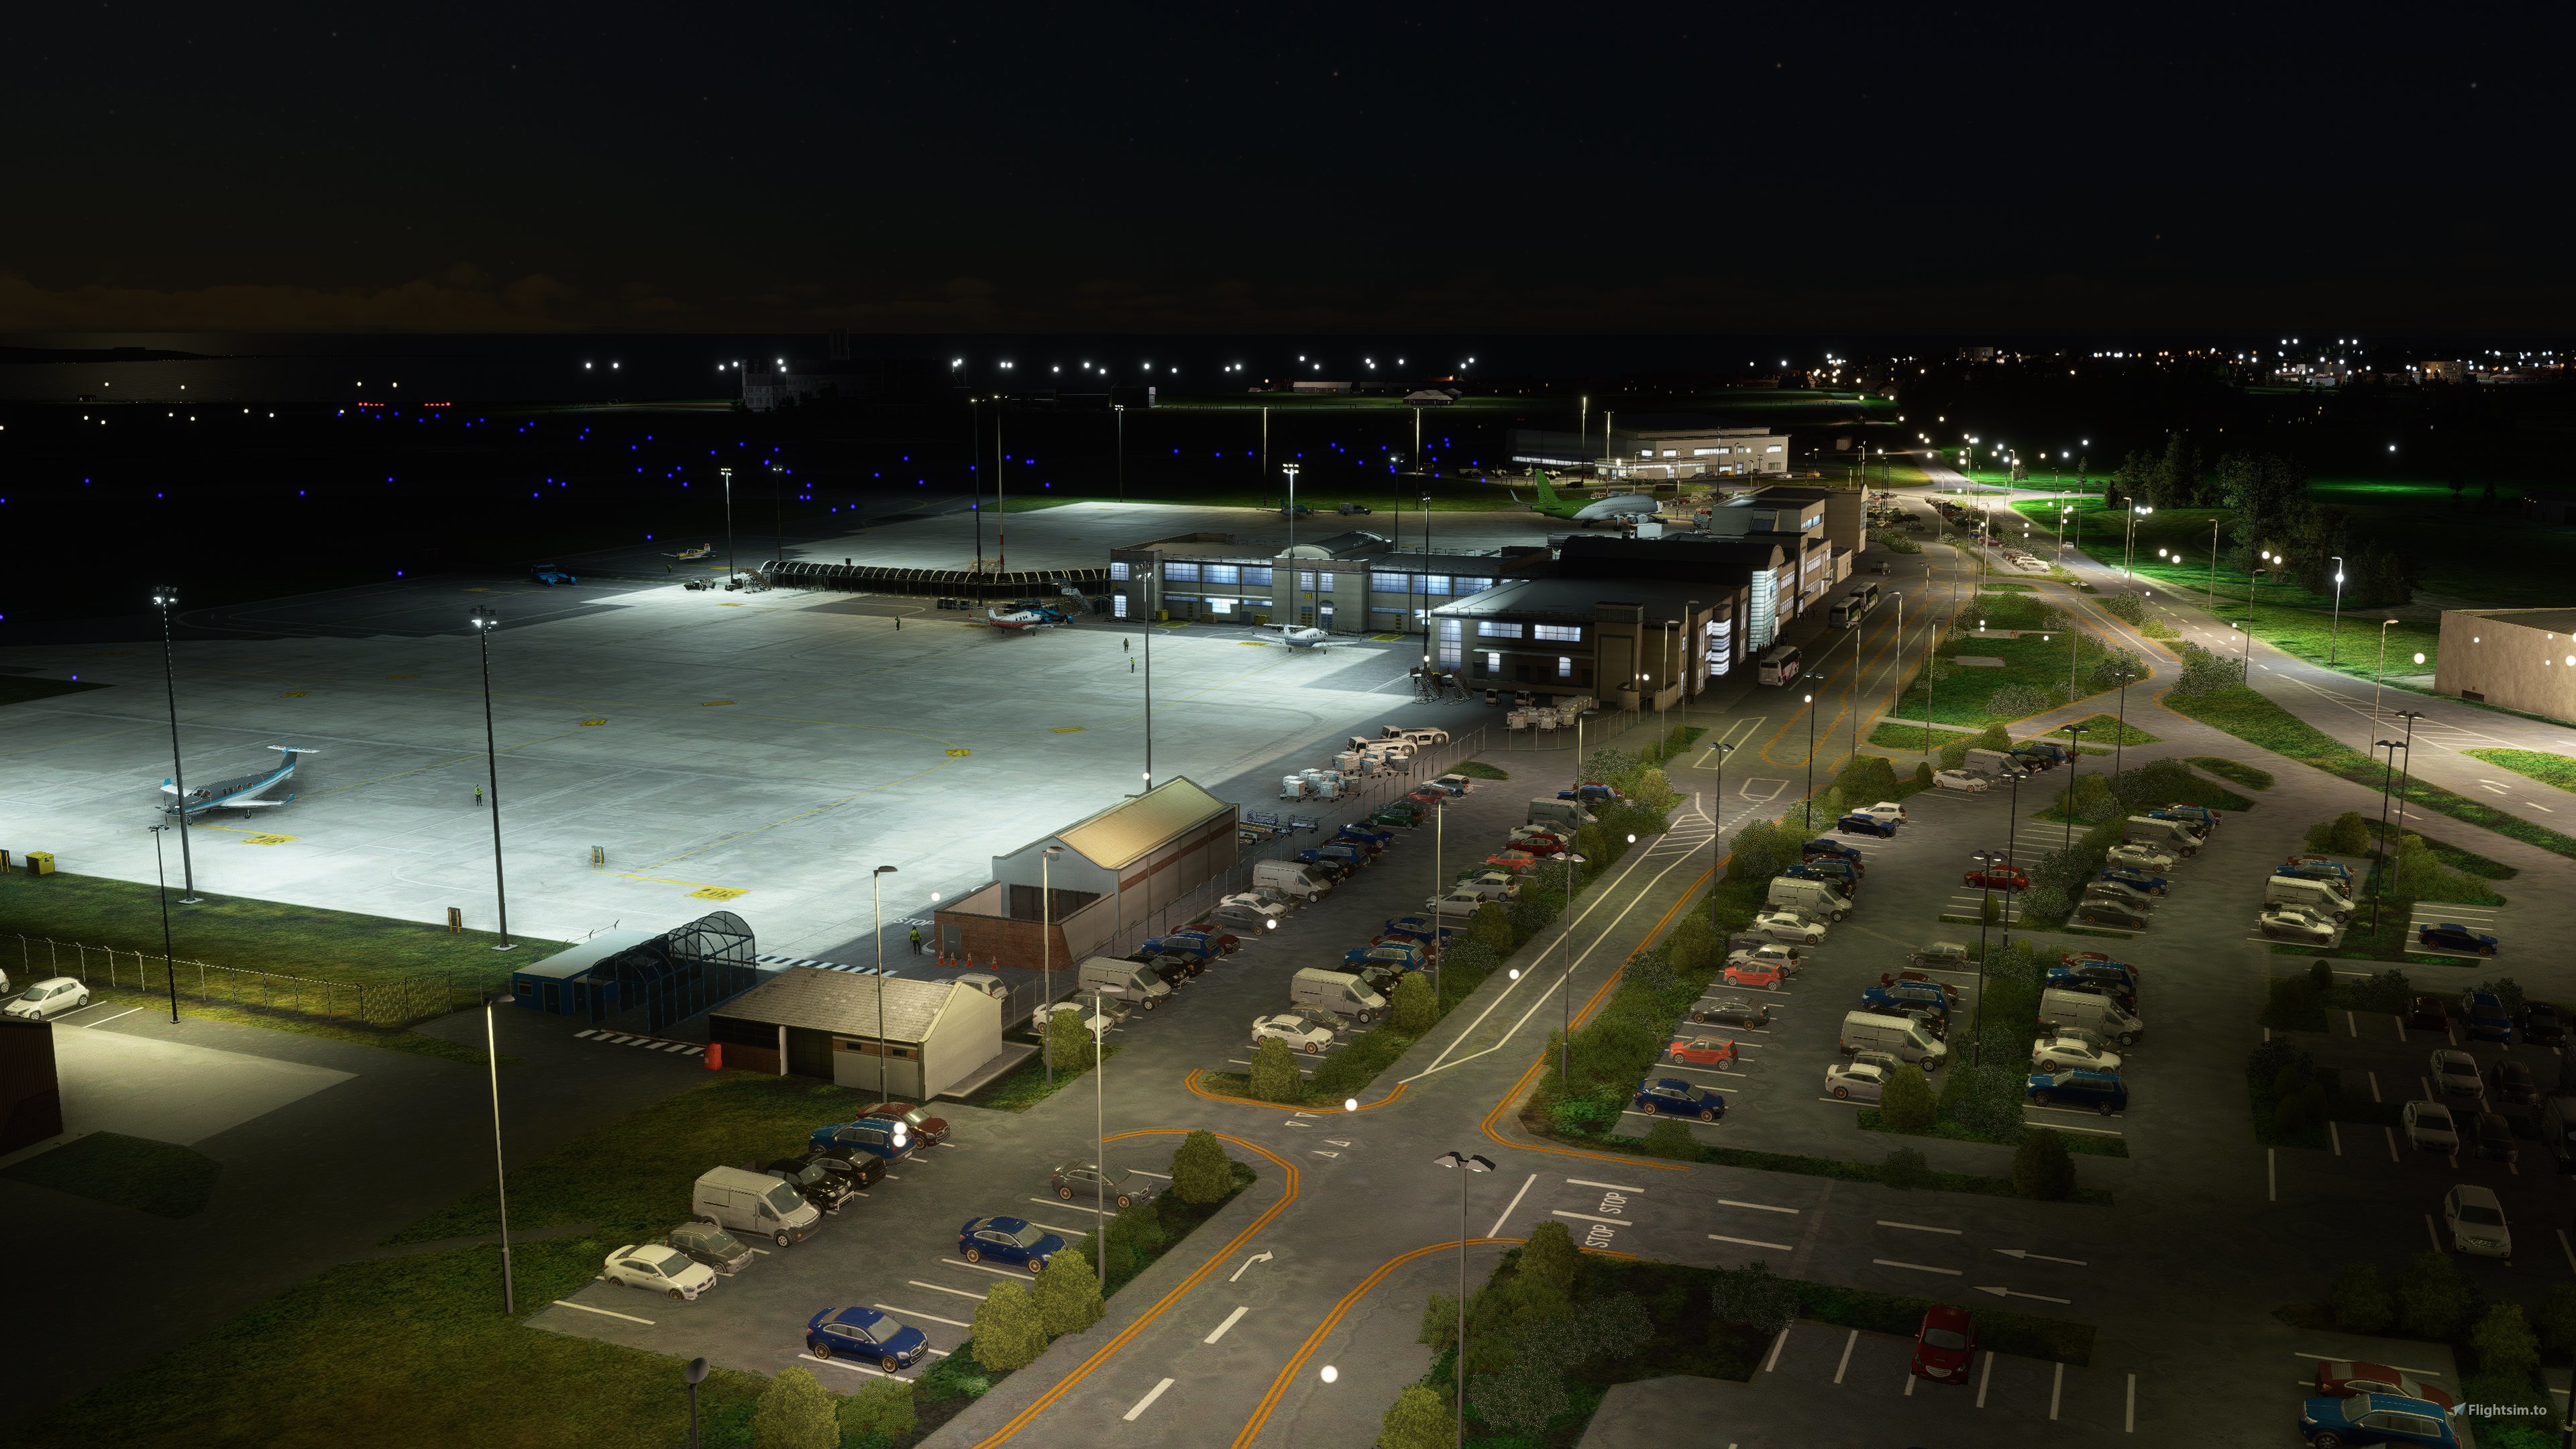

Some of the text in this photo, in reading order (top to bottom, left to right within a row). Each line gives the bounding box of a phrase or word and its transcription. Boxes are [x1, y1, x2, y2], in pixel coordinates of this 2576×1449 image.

[894, 917, 934, 926] STOP
[1599, 1192, 1627, 1214] STOP
[1585, 1224, 1615, 1248] STOP
